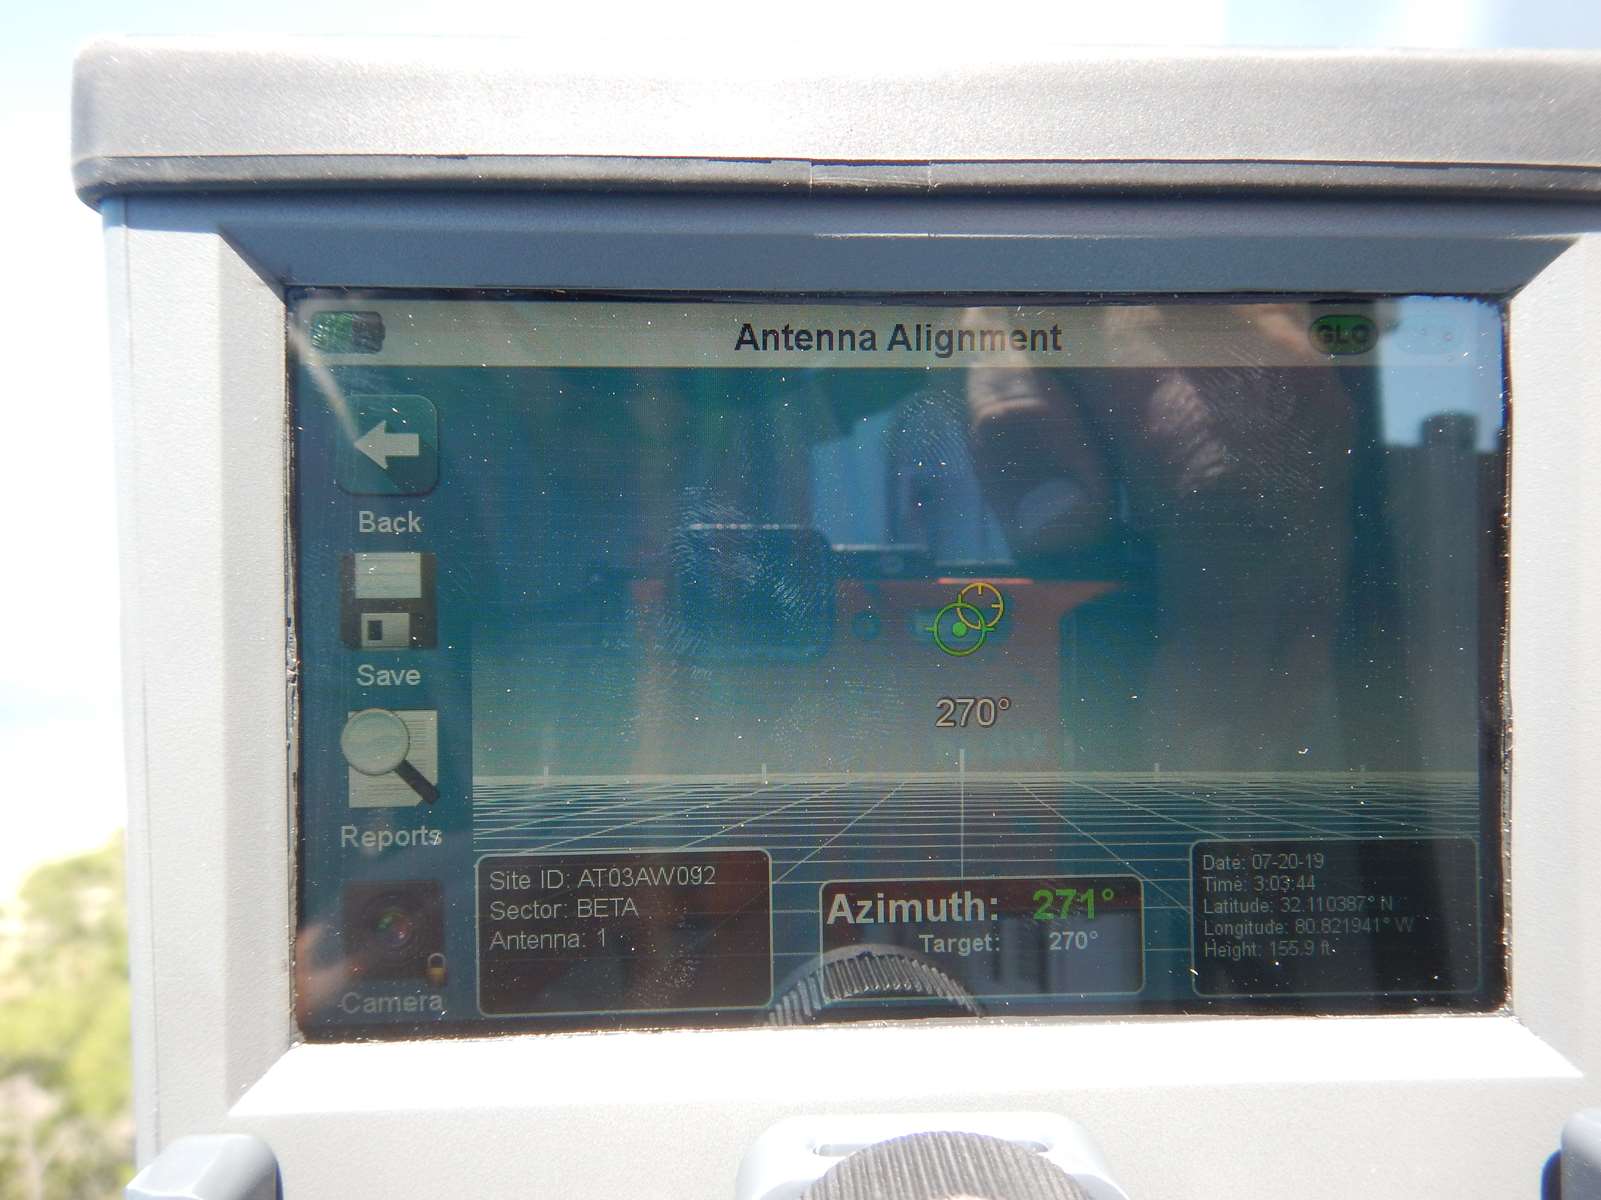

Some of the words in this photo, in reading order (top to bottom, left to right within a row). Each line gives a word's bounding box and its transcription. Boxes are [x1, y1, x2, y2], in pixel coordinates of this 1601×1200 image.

[735, 323, 877, 351] Antenna
[887, 323, 1063, 358] Alignment
[358, 510, 422, 533] Back
[356, 664, 422, 687] Save
[935, 697, 1011, 728] 270°
[340, 826, 443, 851] Reports
[1203, 854, 1246, 870] Date:
[1252, 853, 1325, 870] 07-20-19
[489, 870, 531, 890] Site
[541, 868, 571, 889] ID:
[577, 866, 717, 888] AT03AW092
[1203, 877, 1248, 892] Time:
[1254, 875, 1316, 892] 3:03:44
[489, 900, 568, 920] Sector:
[577, 898, 640, 918] BETA
[826, 890, 998, 925] Azimuth:
[1032, 888, 1115, 920] 271°
[1203, 899, 1273, 914] Latitude:
[1381, 897, 1393, 911] N
[1204, 921, 1288, 938] Longitude:
[1396, 917, 1414, 933] W
[489, 930, 586, 950] Antenna:
[597, 928, 606, 947] 1
[918, 932, 1000, 956] Target:
[1049, 930, 1098, 951] 270°
[1204, 941, 1262, 960] Height:
[341, 992, 444, 1014] Camera
